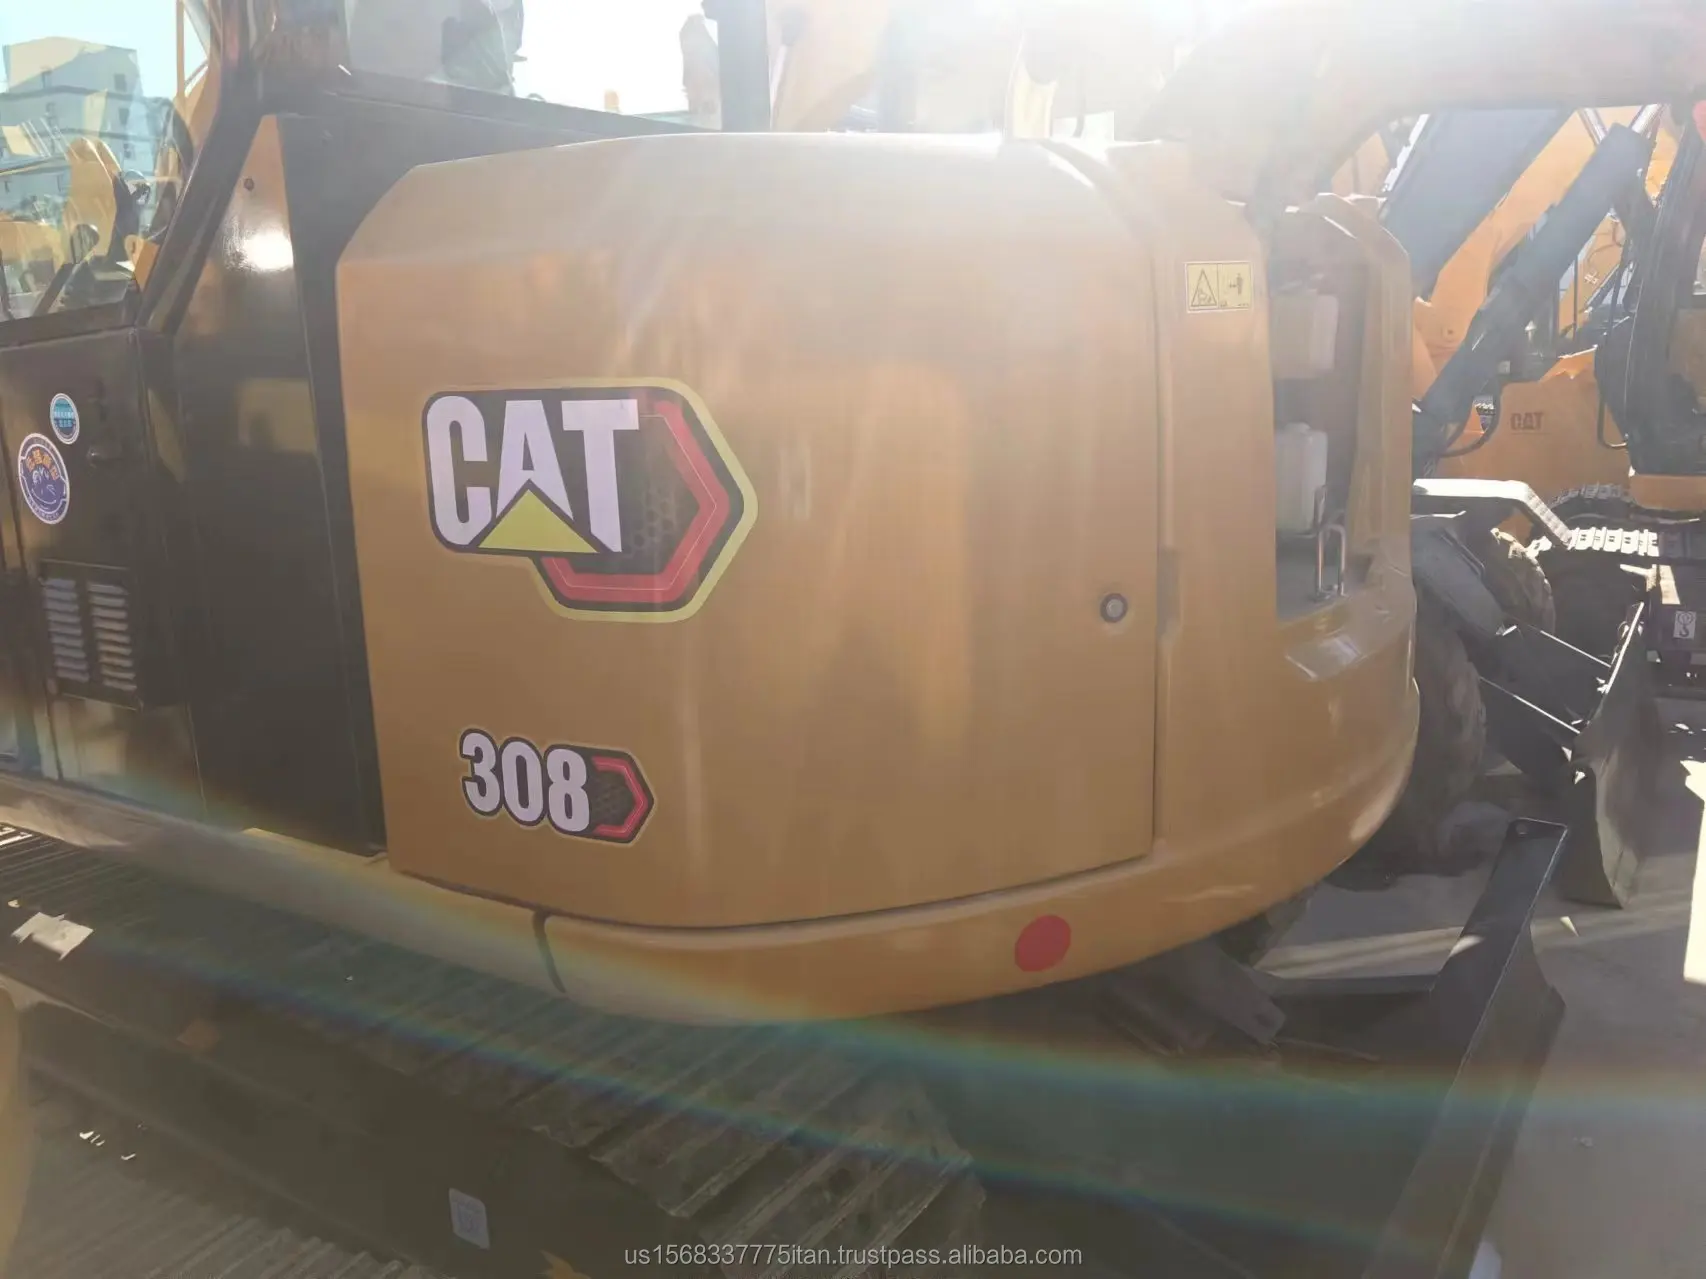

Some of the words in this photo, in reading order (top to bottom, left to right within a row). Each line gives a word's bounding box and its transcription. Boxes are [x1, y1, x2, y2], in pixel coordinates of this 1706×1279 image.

[1510, 412, 1544, 430] CAT
[426, 396, 639, 552] CAT
[462, 732, 589, 832] 308
